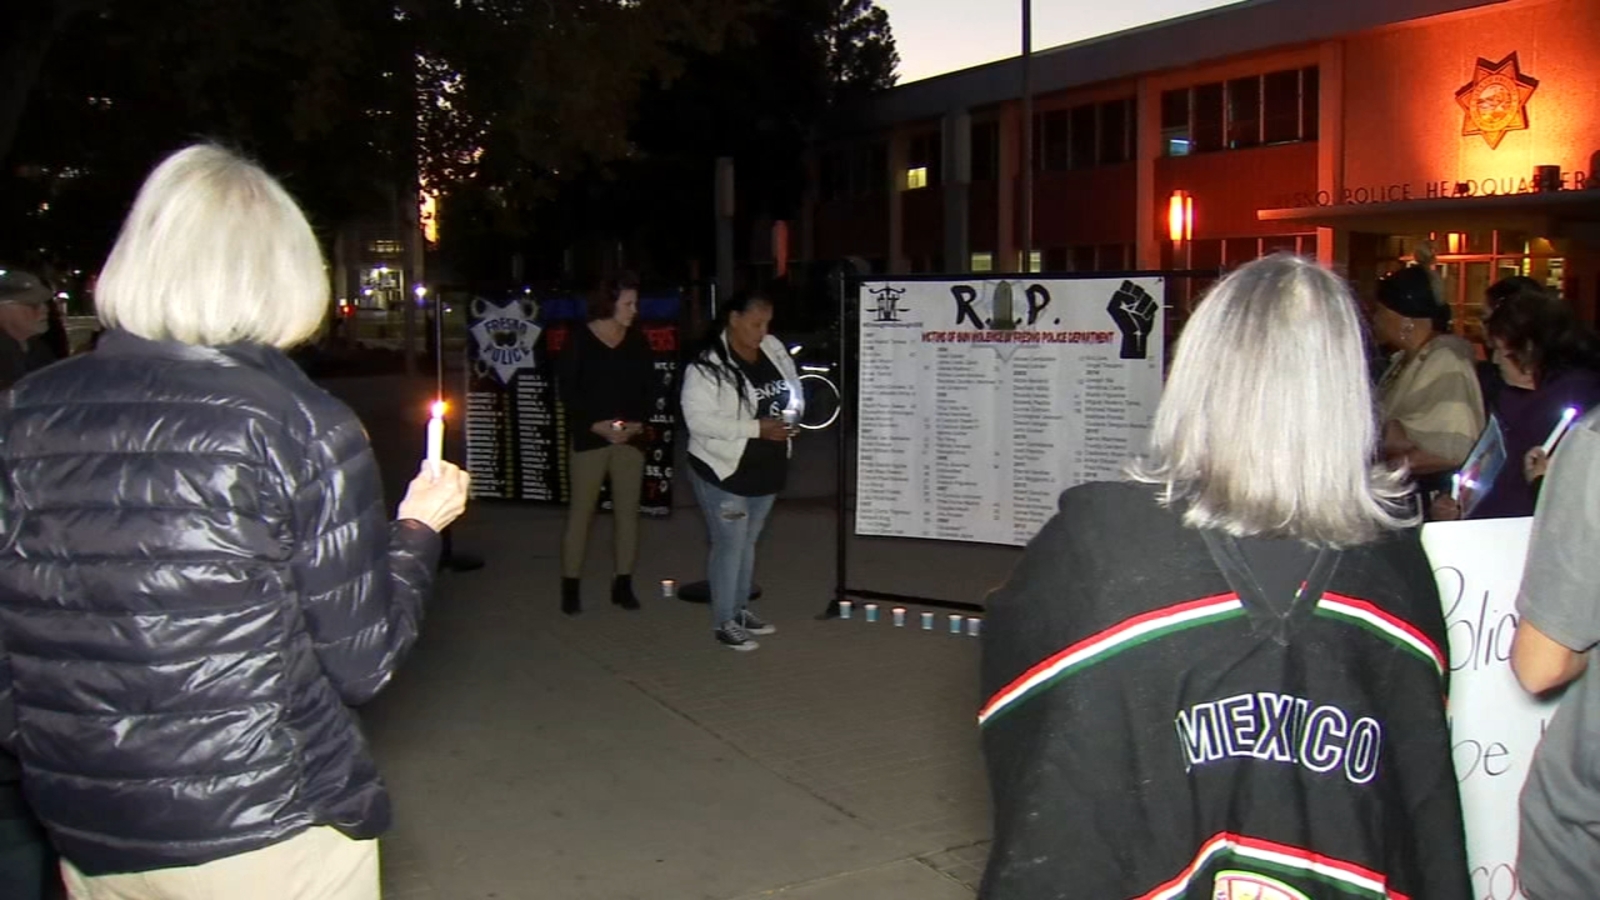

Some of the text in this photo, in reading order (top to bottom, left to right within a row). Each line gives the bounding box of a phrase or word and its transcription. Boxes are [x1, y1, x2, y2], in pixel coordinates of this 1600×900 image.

[1342, 184, 1411, 204] POLICE
[484, 317, 527, 336] FRESNO
[1042, 331, 1067, 344] POLICE
[1068, 331, 1114, 344] DEPARTMENT
[483, 342, 531, 365] POLICE
[1432, 566, 1519, 671] Polic
[1174, 692, 1381, 784] MEXICO
